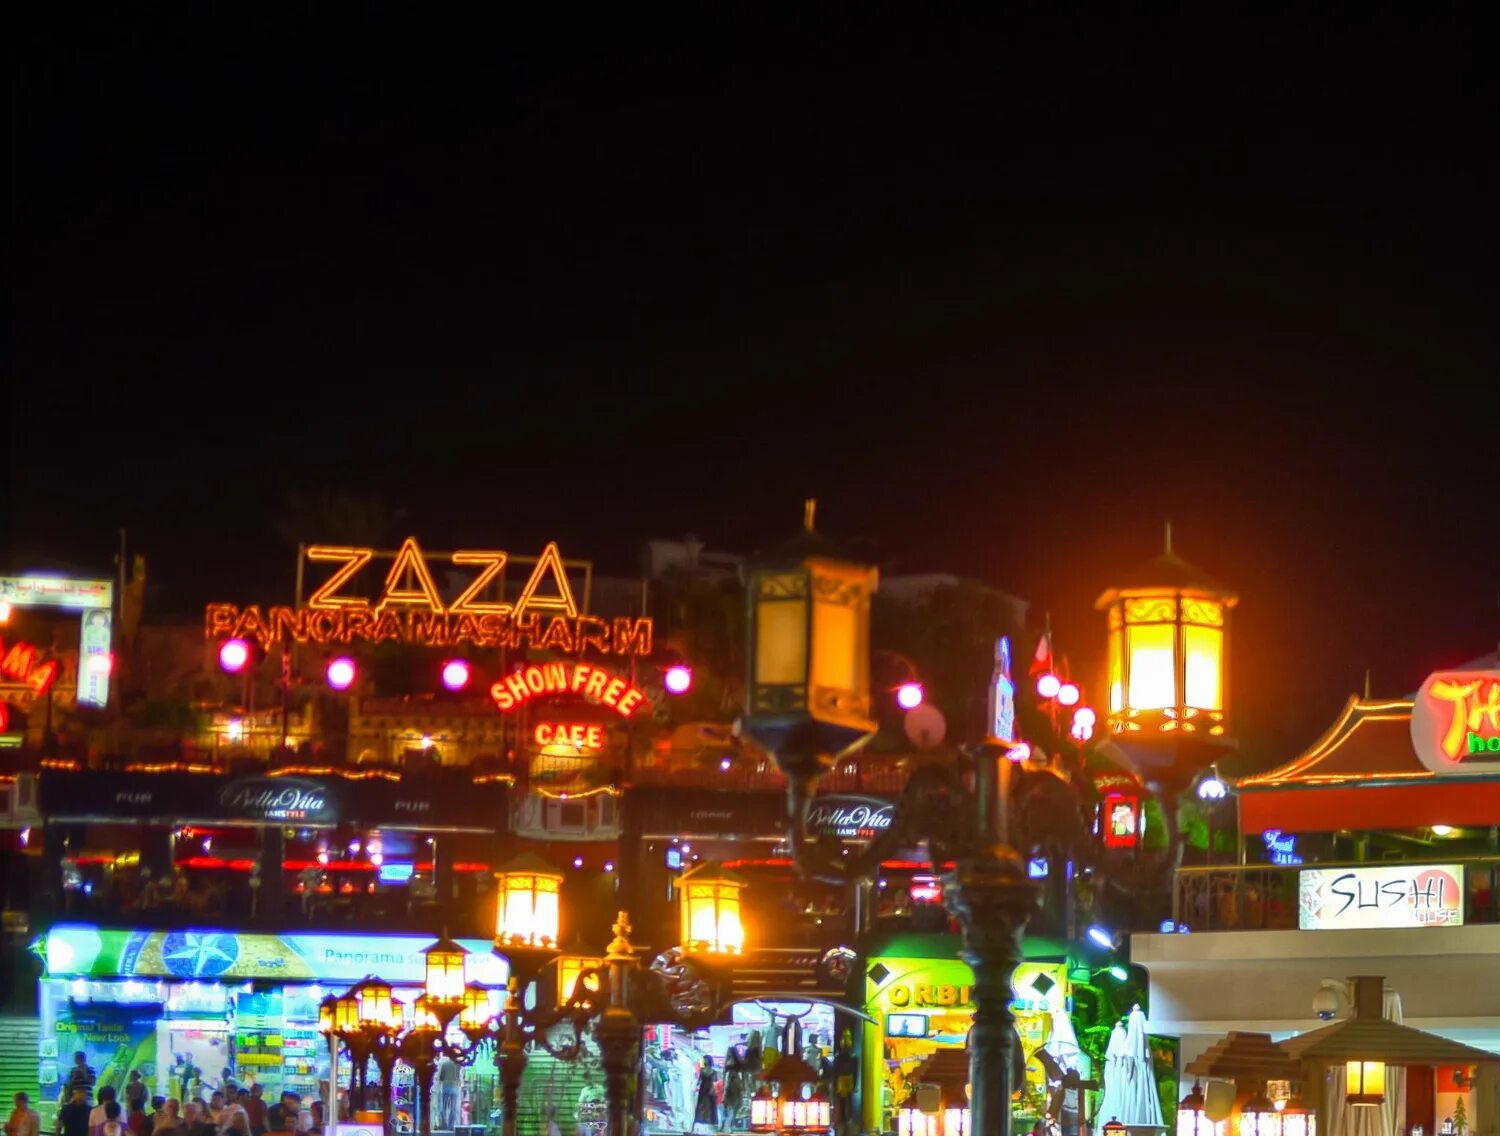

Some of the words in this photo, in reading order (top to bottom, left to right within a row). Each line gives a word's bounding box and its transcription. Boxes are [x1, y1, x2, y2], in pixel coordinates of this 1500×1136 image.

[307, 536, 577, 622] ZAZA
[205, 602, 486, 650] PANORAMA
[480, 611, 653, 656] SHARM
[490, 662, 567, 710] SHOW
[571, 664, 643, 716] FREE
[535, 723, 602, 749] CAFE
[1331, 873, 1443, 918] SUSHI
[325, 949, 403, 965] Panorama
[887, 983, 971, 1007] ORBI
